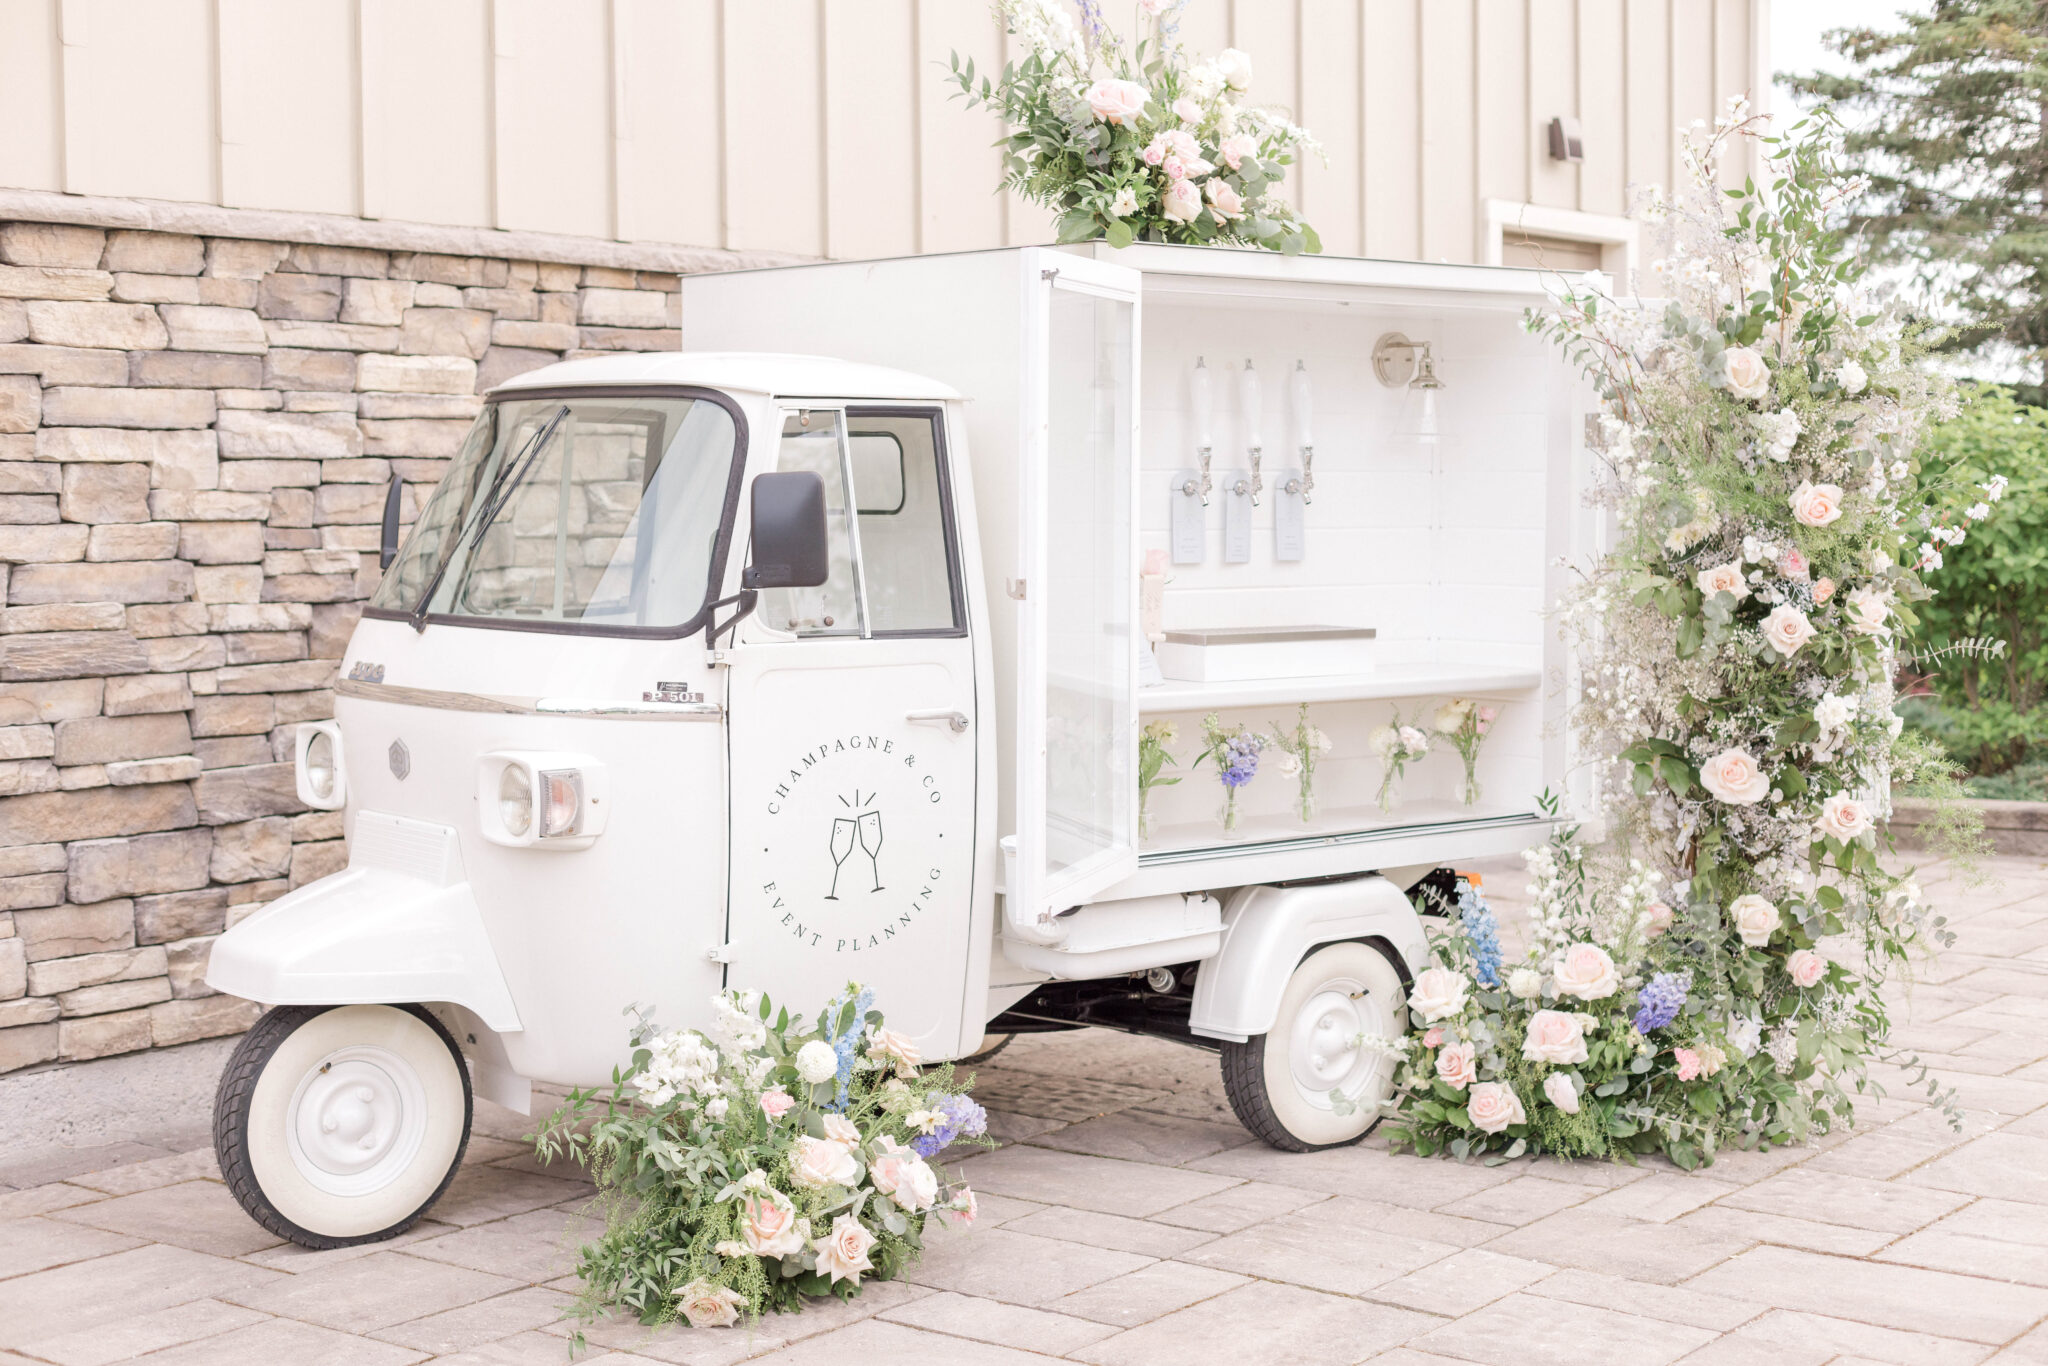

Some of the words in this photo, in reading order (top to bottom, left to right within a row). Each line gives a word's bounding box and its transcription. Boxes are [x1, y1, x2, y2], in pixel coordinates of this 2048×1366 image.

[650, 691, 662, 702] P
[670, 691, 697, 703] 501
[767, 735, 894, 815] CHAMPAGNE
[904, 754, 916, 768] &
[922, 775, 941, 803] CO
[763, 881, 822, 947] EVENT
[836, 868, 941, 952] PLANNING
